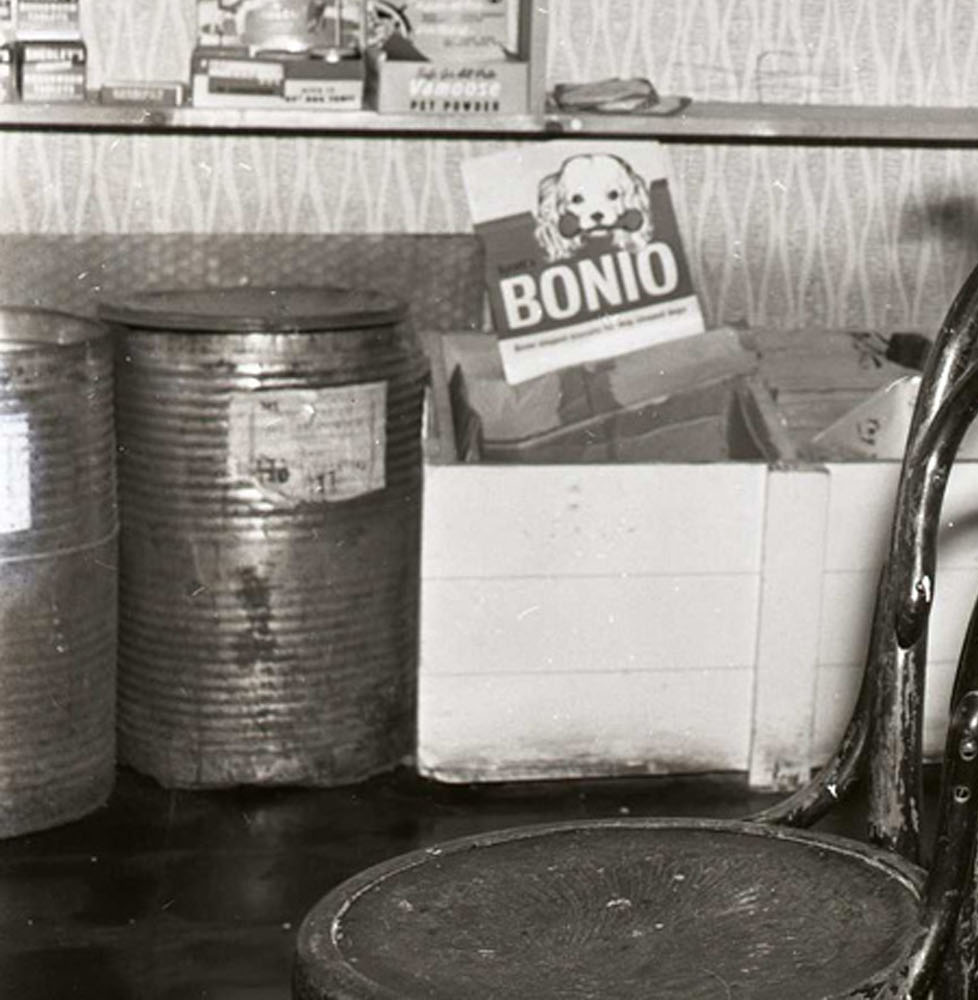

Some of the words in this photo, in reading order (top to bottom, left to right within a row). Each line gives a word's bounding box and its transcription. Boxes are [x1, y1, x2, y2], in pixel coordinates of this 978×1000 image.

[410, 100, 436, 112] PET
[443, 101, 500, 113] POWDER
[500, 241, 680, 331] BONIO
